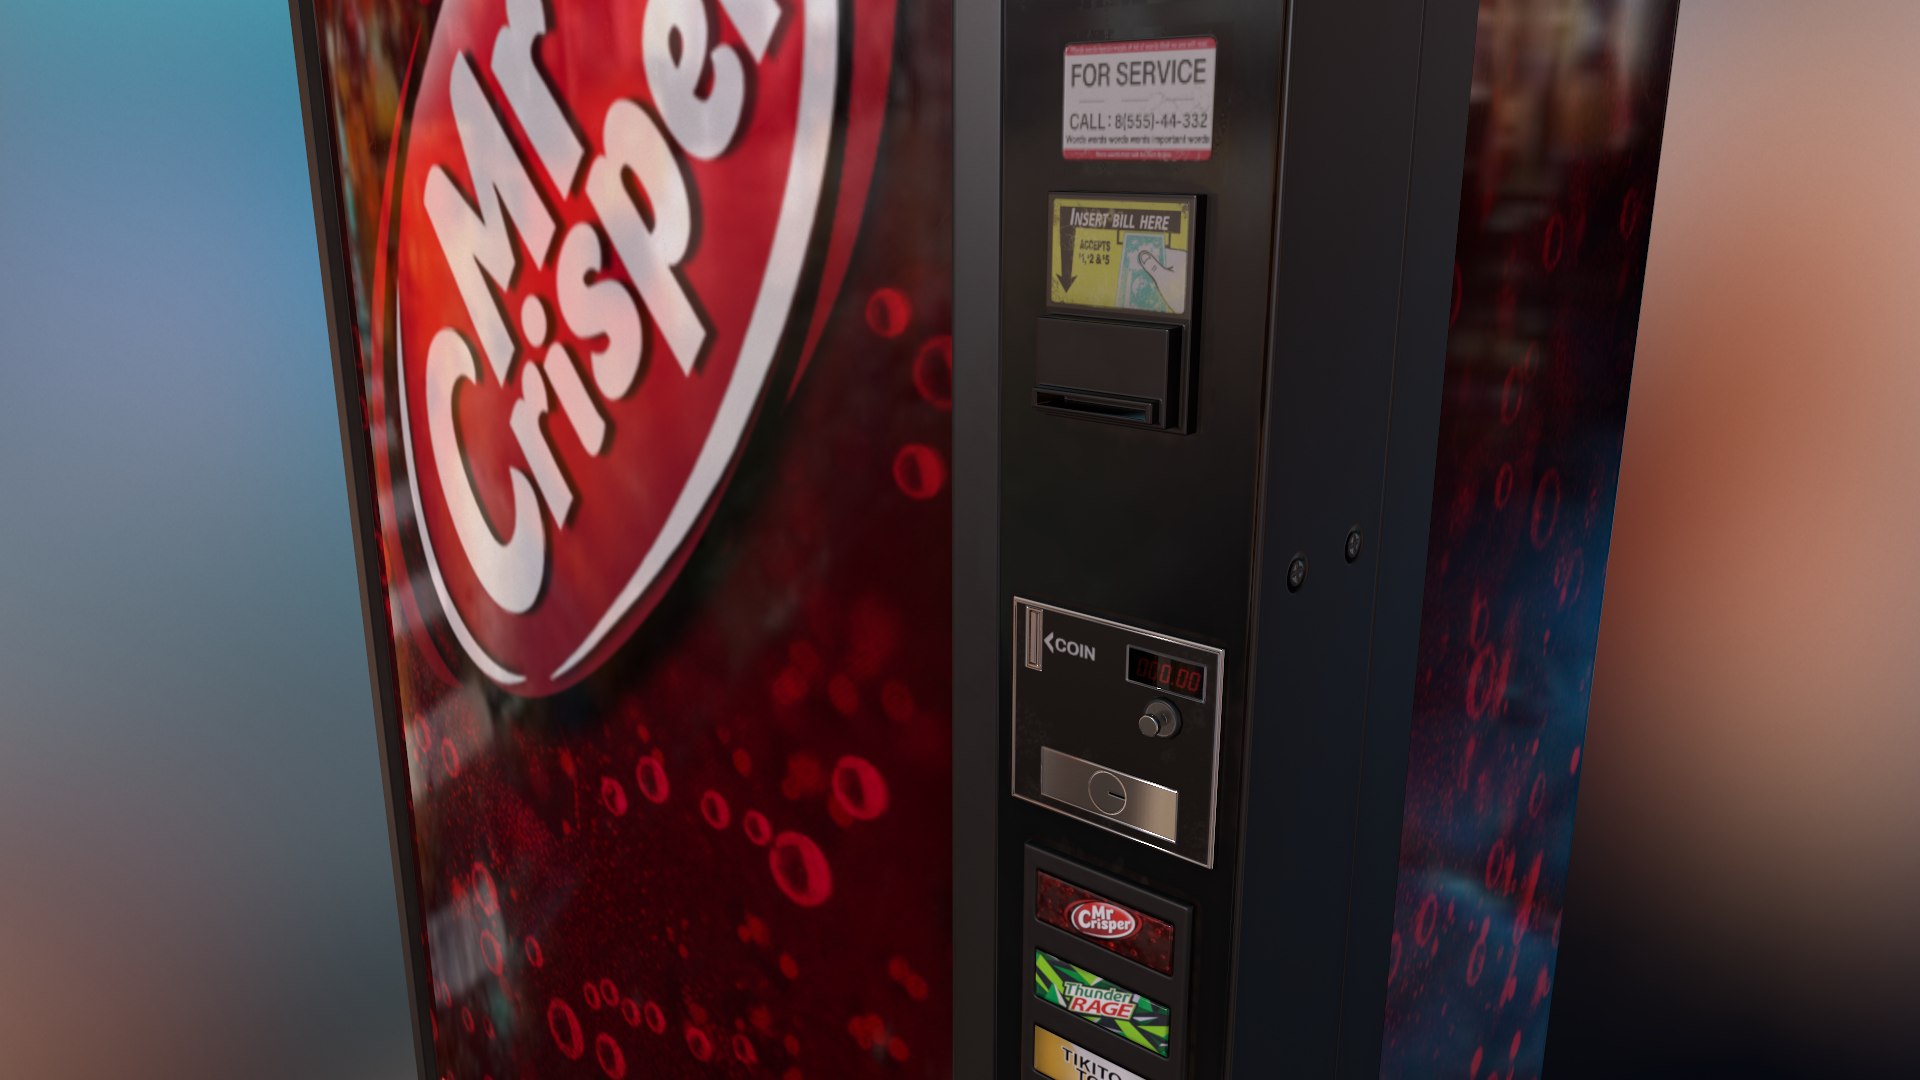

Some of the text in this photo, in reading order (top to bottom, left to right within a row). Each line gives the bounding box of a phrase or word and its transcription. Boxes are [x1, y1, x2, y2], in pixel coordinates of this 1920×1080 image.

[1071, 58, 1206, 88] FOR SERVICE
[1115, 112, 1208, 131] 8(555)-44-332
[423, 0, 585, 388] Mr
[1069, 207, 1171, 231] INSERT BILL HERE
[1079, 239, 1111, 252] ACCEPTS
[1055, 637, 1096, 662] COIN
[1078, 908, 1131, 934] Crisper
[1092, 905, 1114, 920] Mr
[1065, 982, 1130, 1002] Thunder
[1071, 997, 1133, 1018] RAGE
